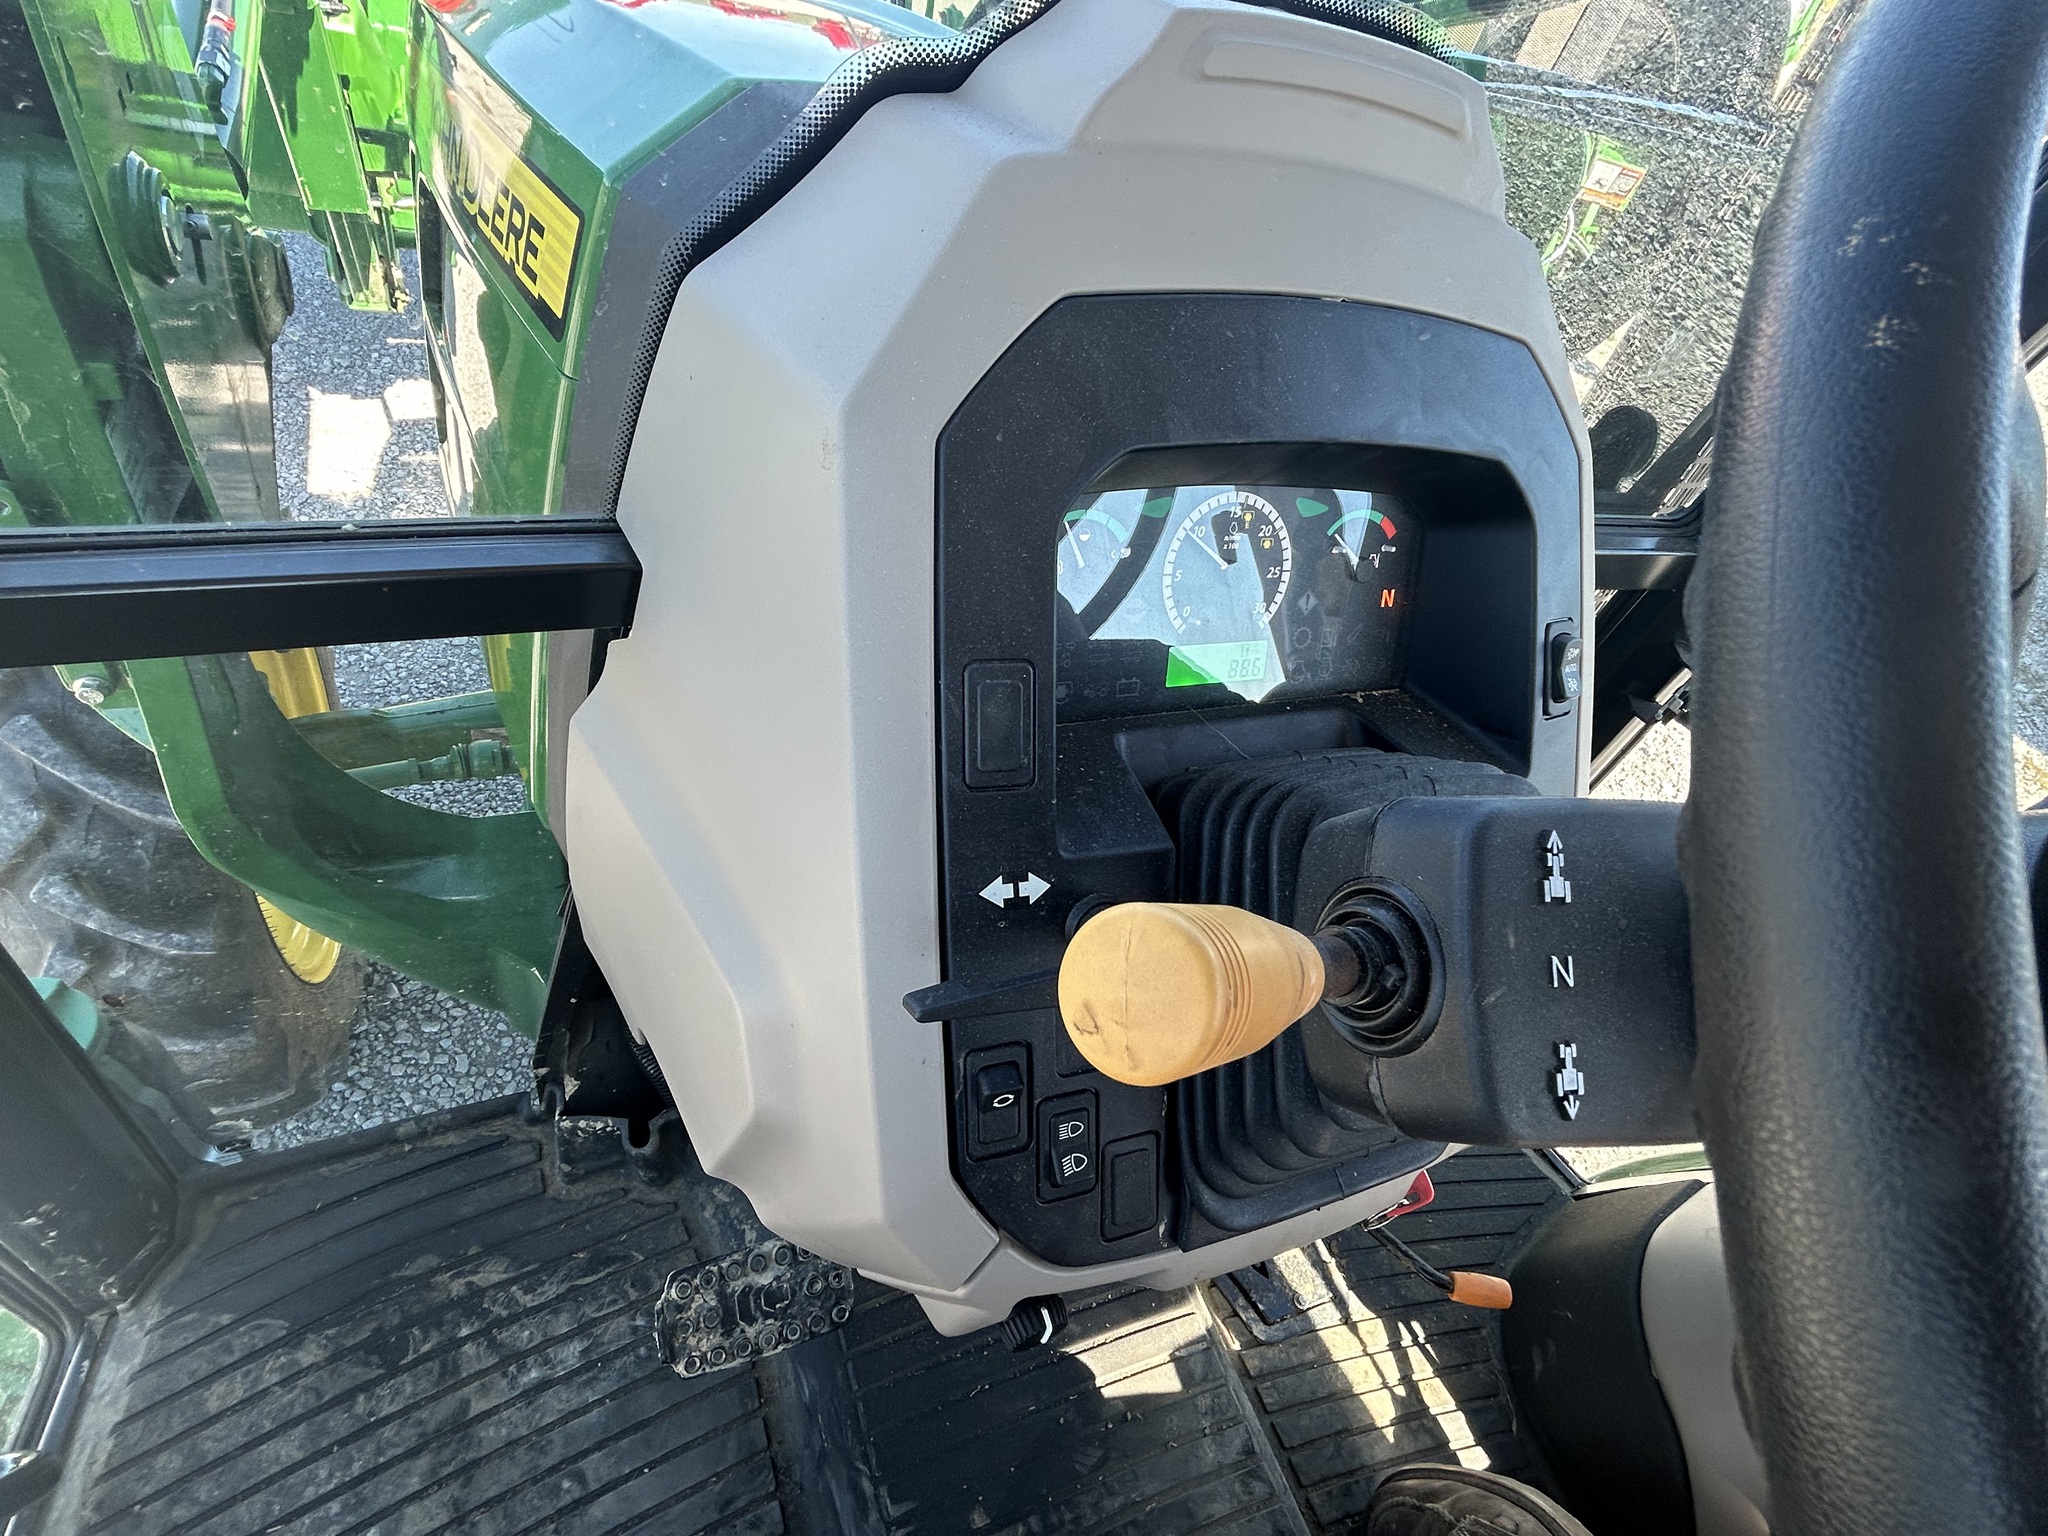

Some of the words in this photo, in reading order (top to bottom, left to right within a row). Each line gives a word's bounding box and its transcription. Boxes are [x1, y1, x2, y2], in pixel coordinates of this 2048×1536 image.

[463, 130, 546, 286] DEERE
[1230, 506, 1242, 518] 15
[1193, 525, 1205, 537] 10
[1258, 525, 1272, 536] 20
[1174, 570, 1182, 581] 5
[1267, 566, 1281, 578] 25
[1380, 589, 1396, 608] N
[1182, 606, 1191, 617] 0
[1252, 602, 1266, 614] 30
[1550, 955, 1575, 988] N
